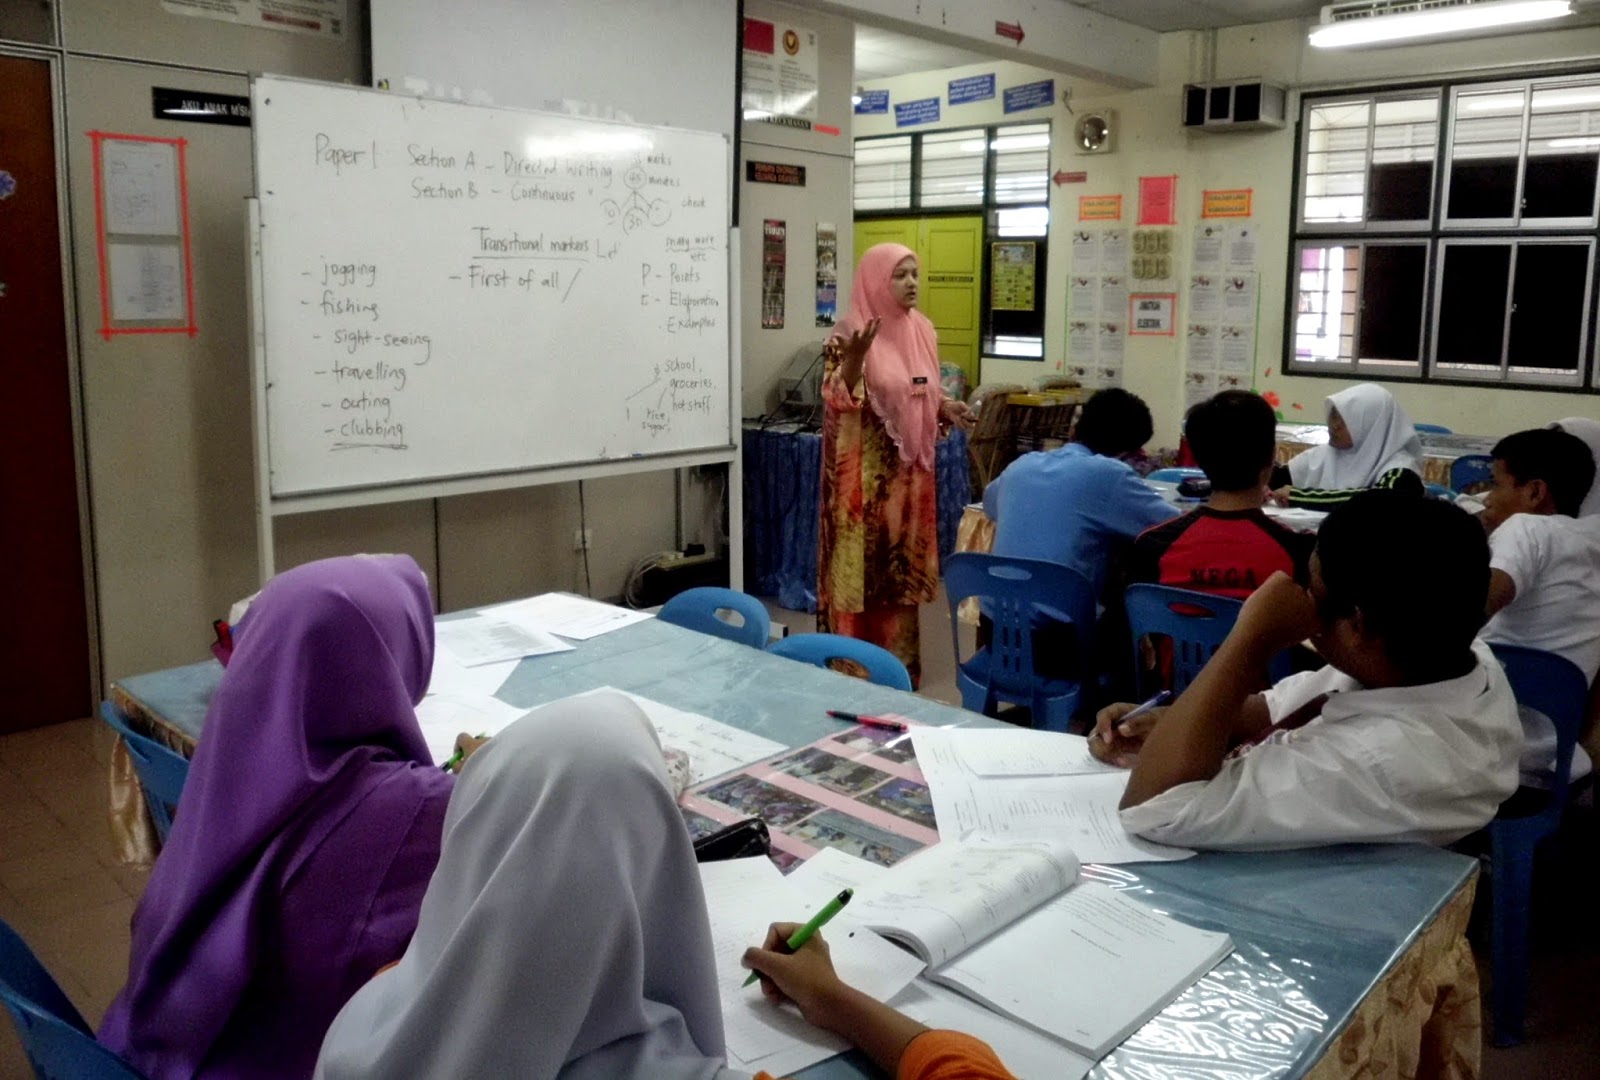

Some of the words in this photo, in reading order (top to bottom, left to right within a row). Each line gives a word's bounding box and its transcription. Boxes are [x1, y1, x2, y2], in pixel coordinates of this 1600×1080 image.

[315, 132, 366, 176] Paper
[407, 143, 456, 168] Section
[462, 150, 475, 170] A
[411, 176, 462, 199] Section
[467, 181, 478, 199] B
[510, 180, 576, 201] Continuous
[471, 226, 543, 252] Transitional
[550, 235, 589, 251] markers
[319, 255, 377, 287] jogging
[468, 264, 510, 288] First
[518, 268, 534, 291] of
[541, 270, 559, 288] all
[320, 290, 378, 321] fishing
[334, 329, 432, 366] sight-seeing
[332, 360, 406, 391] travelling
[340, 391, 391, 421] outing
[340, 419, 404, 447] clubbing
